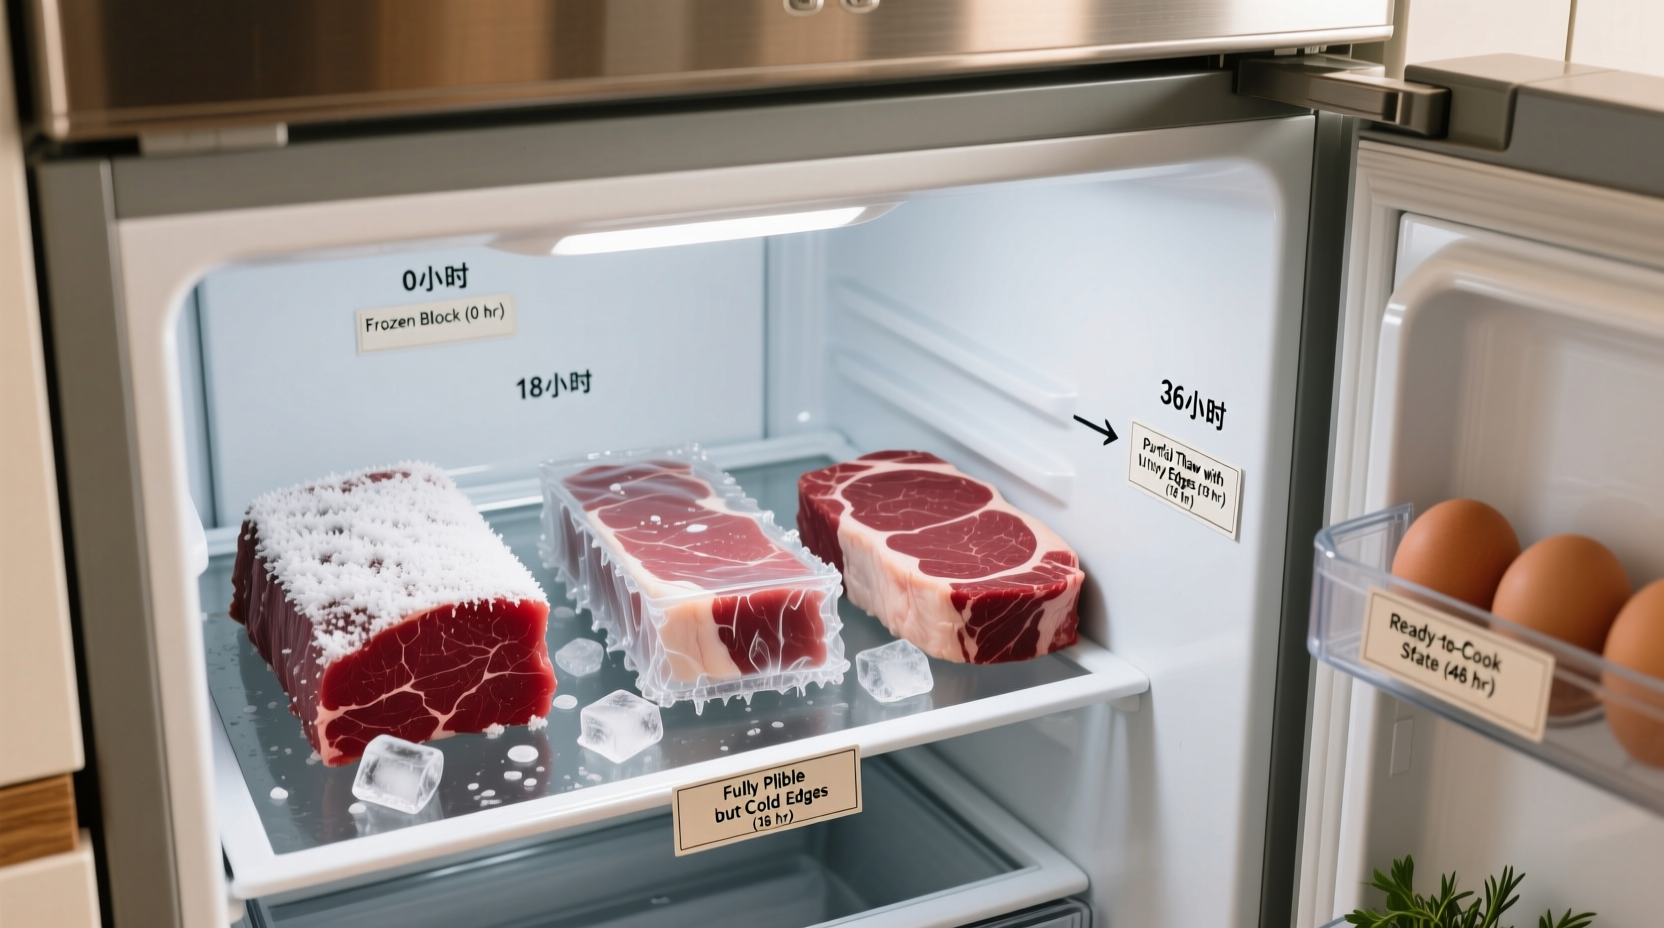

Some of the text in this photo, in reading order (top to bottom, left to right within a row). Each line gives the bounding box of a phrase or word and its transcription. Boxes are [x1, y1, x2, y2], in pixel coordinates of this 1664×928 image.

[402, 262, 469, 292] 0小时
[365, 302, 505, 332] Frozen Block (0 hr)
[516, 369, 592, 400] 18小时
[1160, 379, 1227, 431] 36小时
[1471, 670, 1496, 699] hr)
[723, 769, 806, 801] Fully Plible
[715, 786, 829, 823] but Cold Edges
[775, 809, 794, 825] hr)
